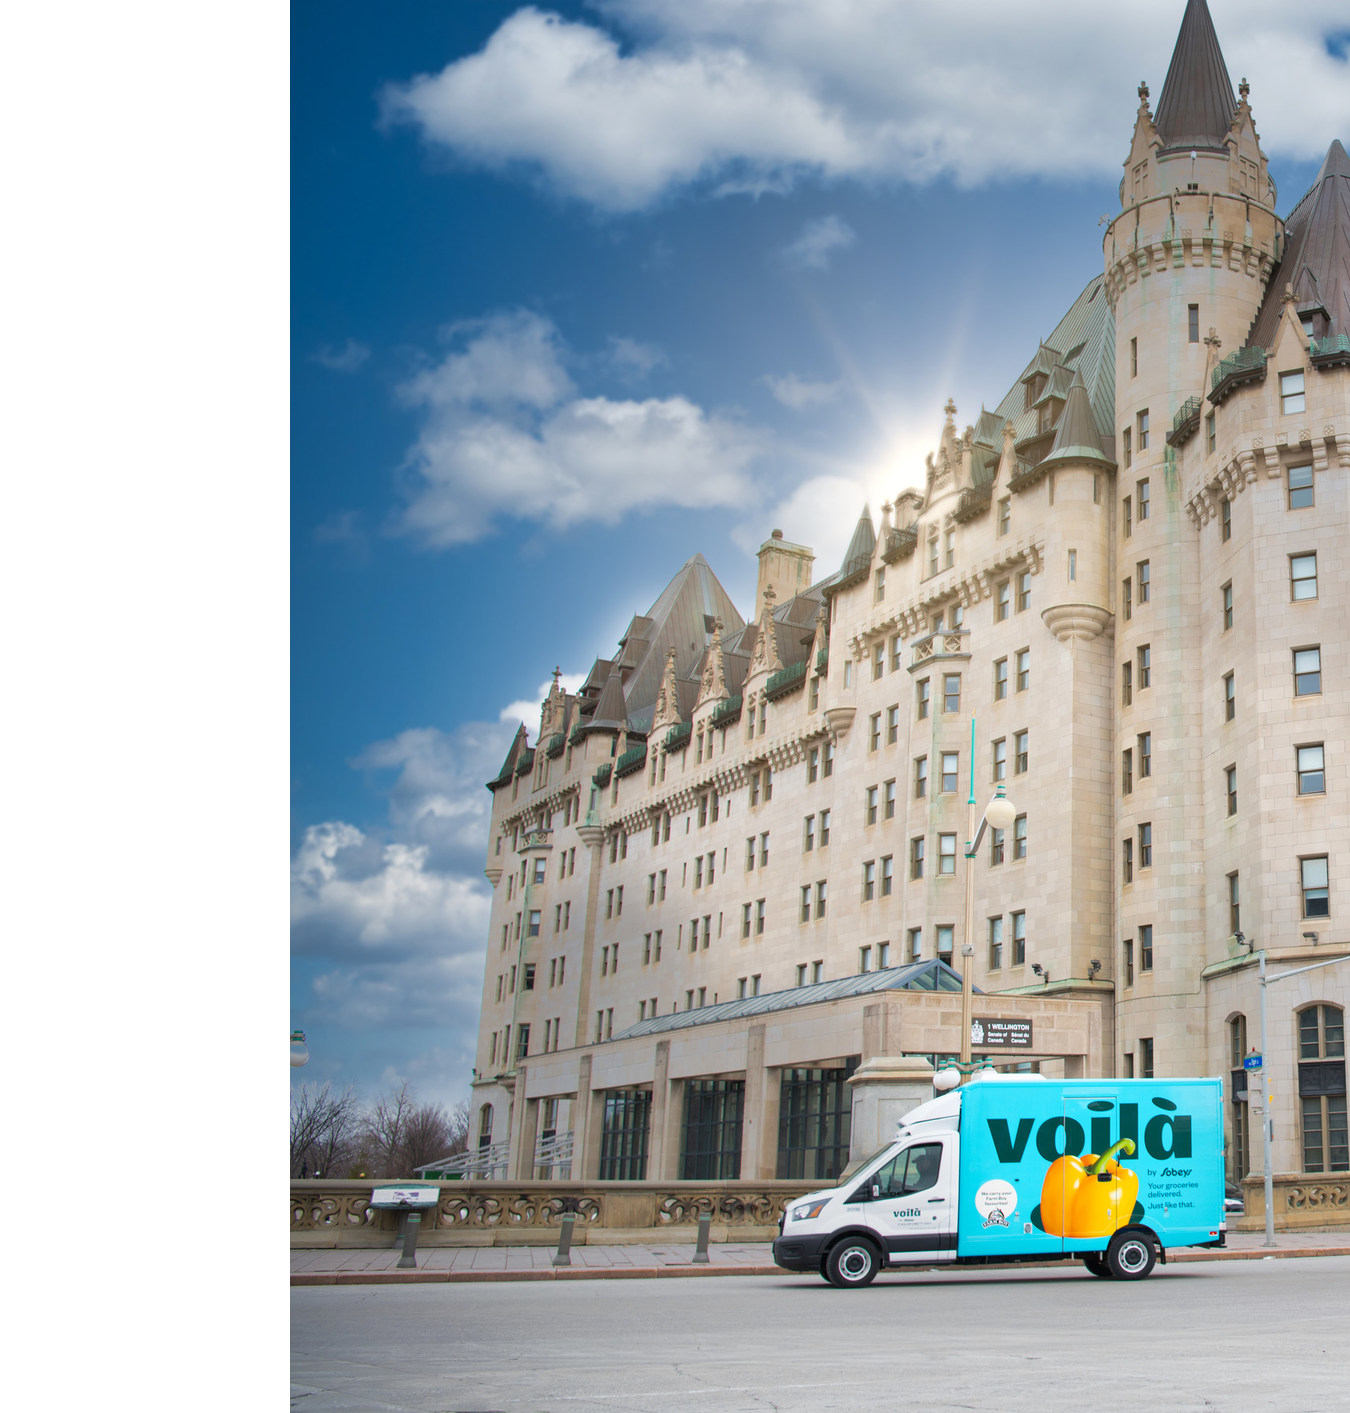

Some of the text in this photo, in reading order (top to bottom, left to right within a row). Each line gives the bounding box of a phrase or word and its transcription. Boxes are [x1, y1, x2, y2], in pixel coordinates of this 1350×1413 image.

[987, 1097, 1192, 1164] voilà
[1147, 1167, 1192, 1177] by Sobeys
[1166, 1182, 1199, 1190] groceries
[1148, 1190, 1182, 1198] delivered.
[893, 1208, 921, 1217] voilà
